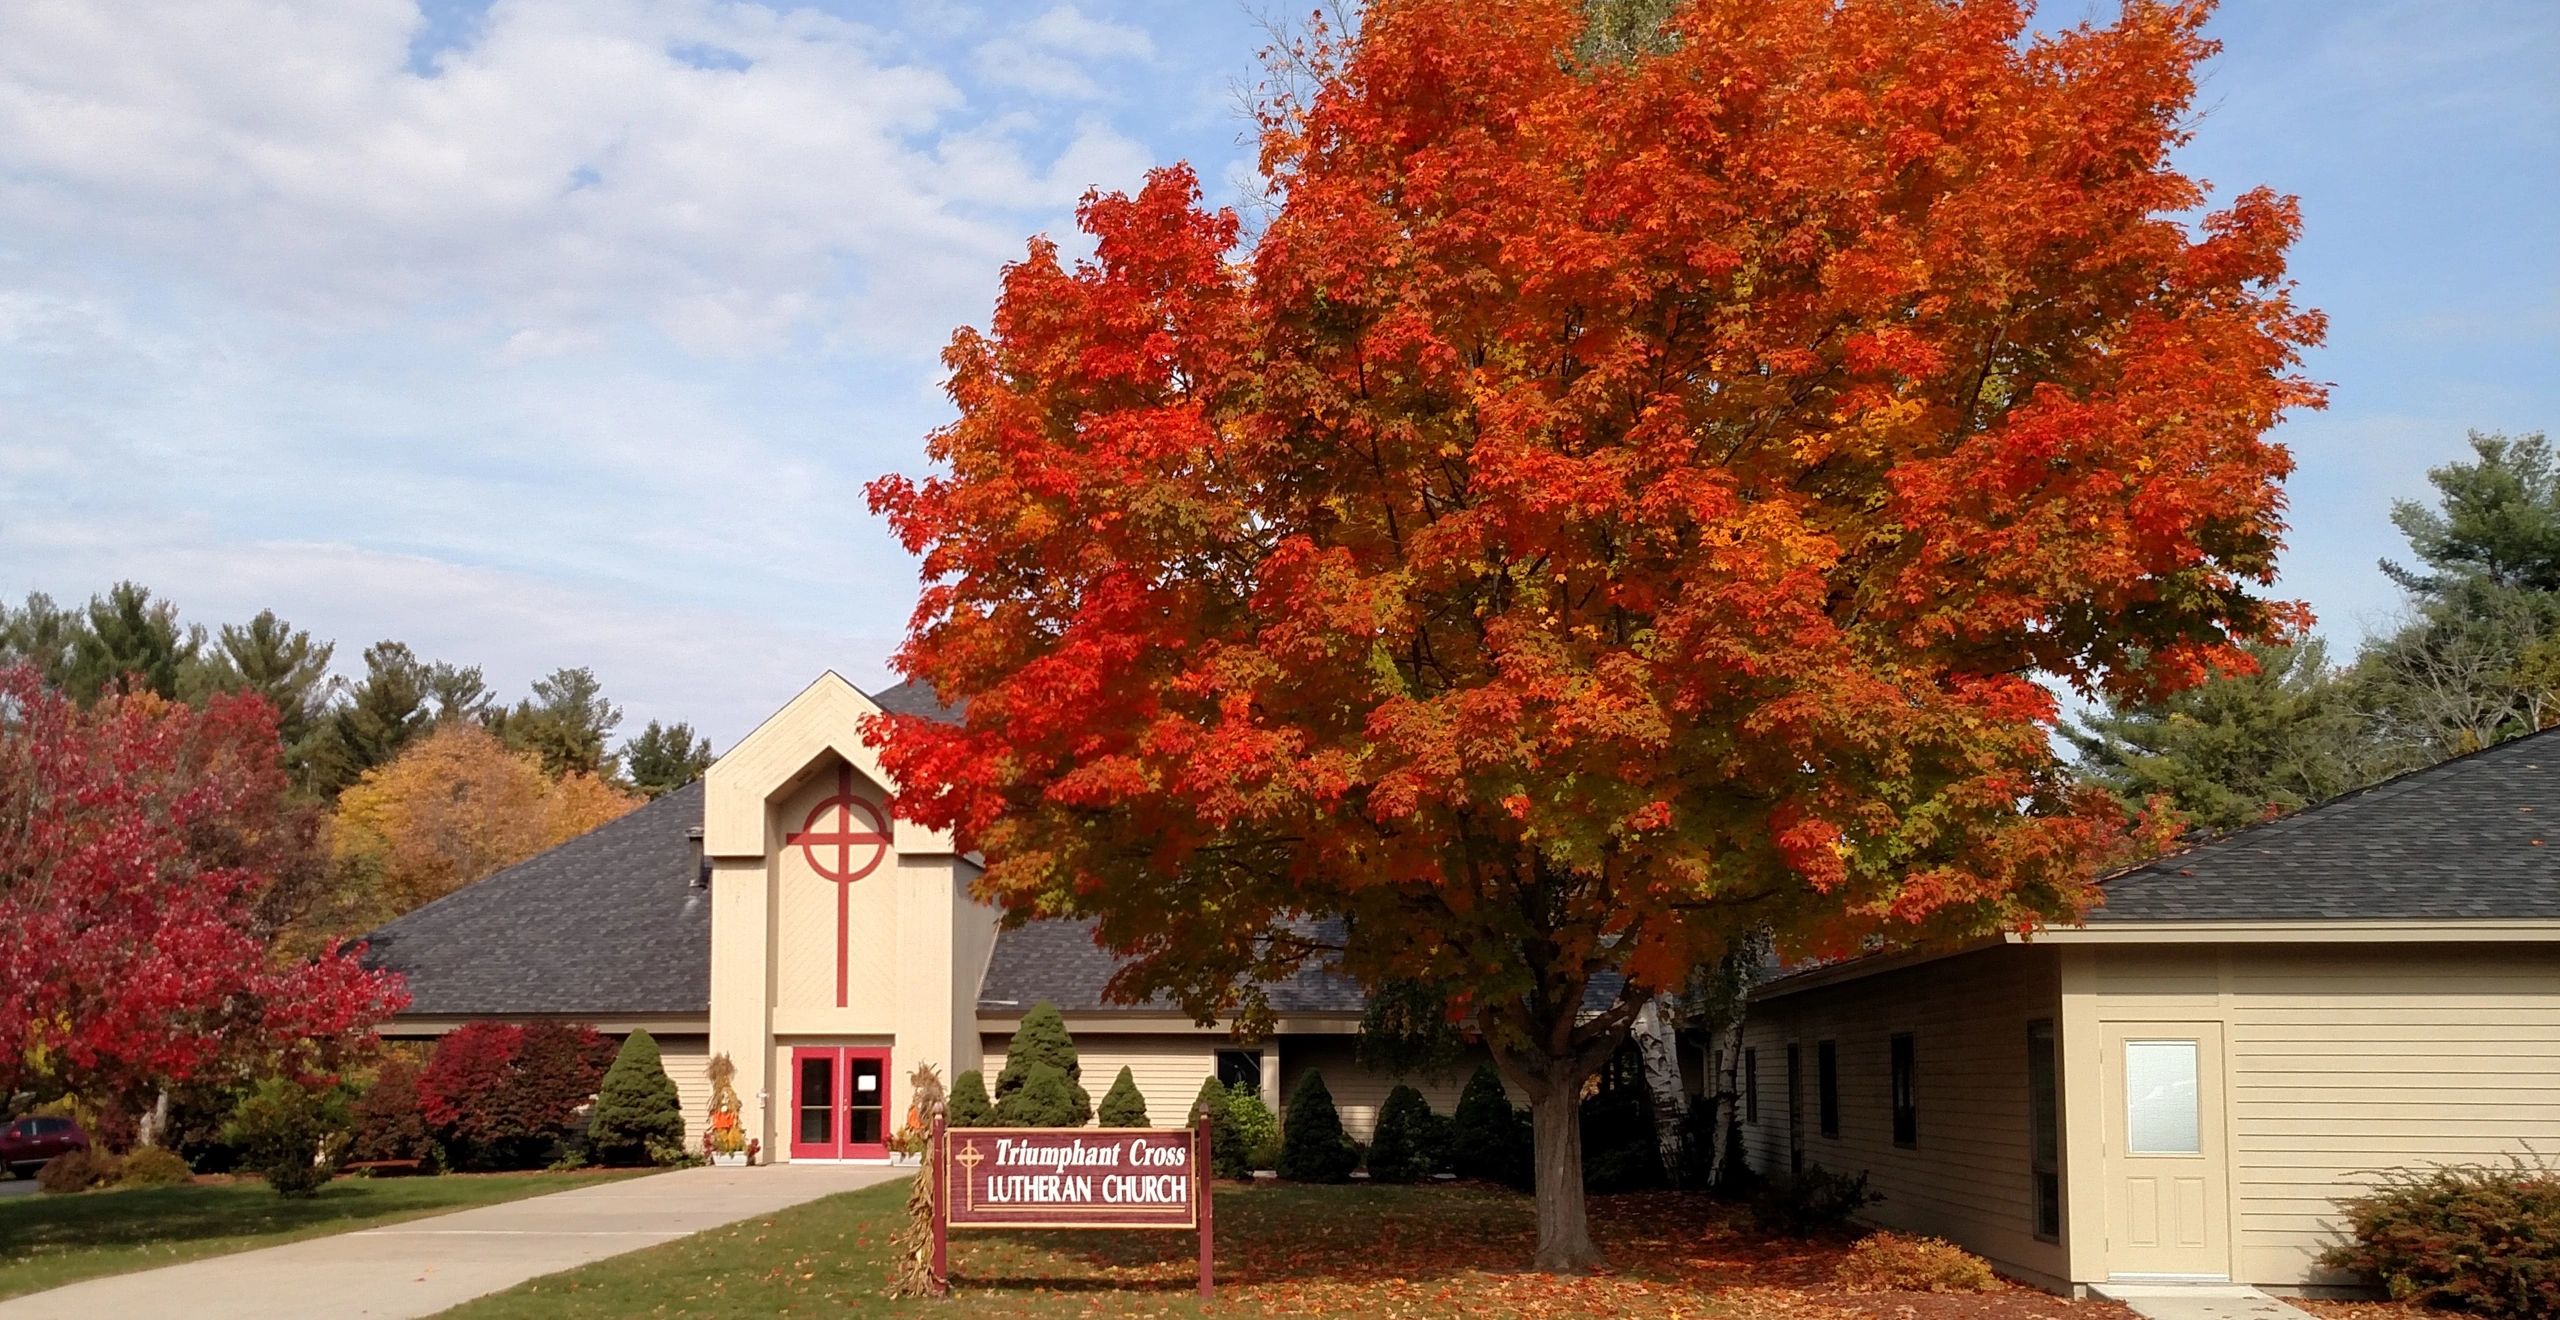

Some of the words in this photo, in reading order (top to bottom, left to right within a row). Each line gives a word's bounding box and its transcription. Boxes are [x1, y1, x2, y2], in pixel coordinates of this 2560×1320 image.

[995, 1138, 1121, 1174] Triumphant
[1129, 1138, 1186, 1167] Cross
[987, 1175, 1092, 1202] LUTHERAN
[1102, 1174, 1187, 1203] CHURCH
